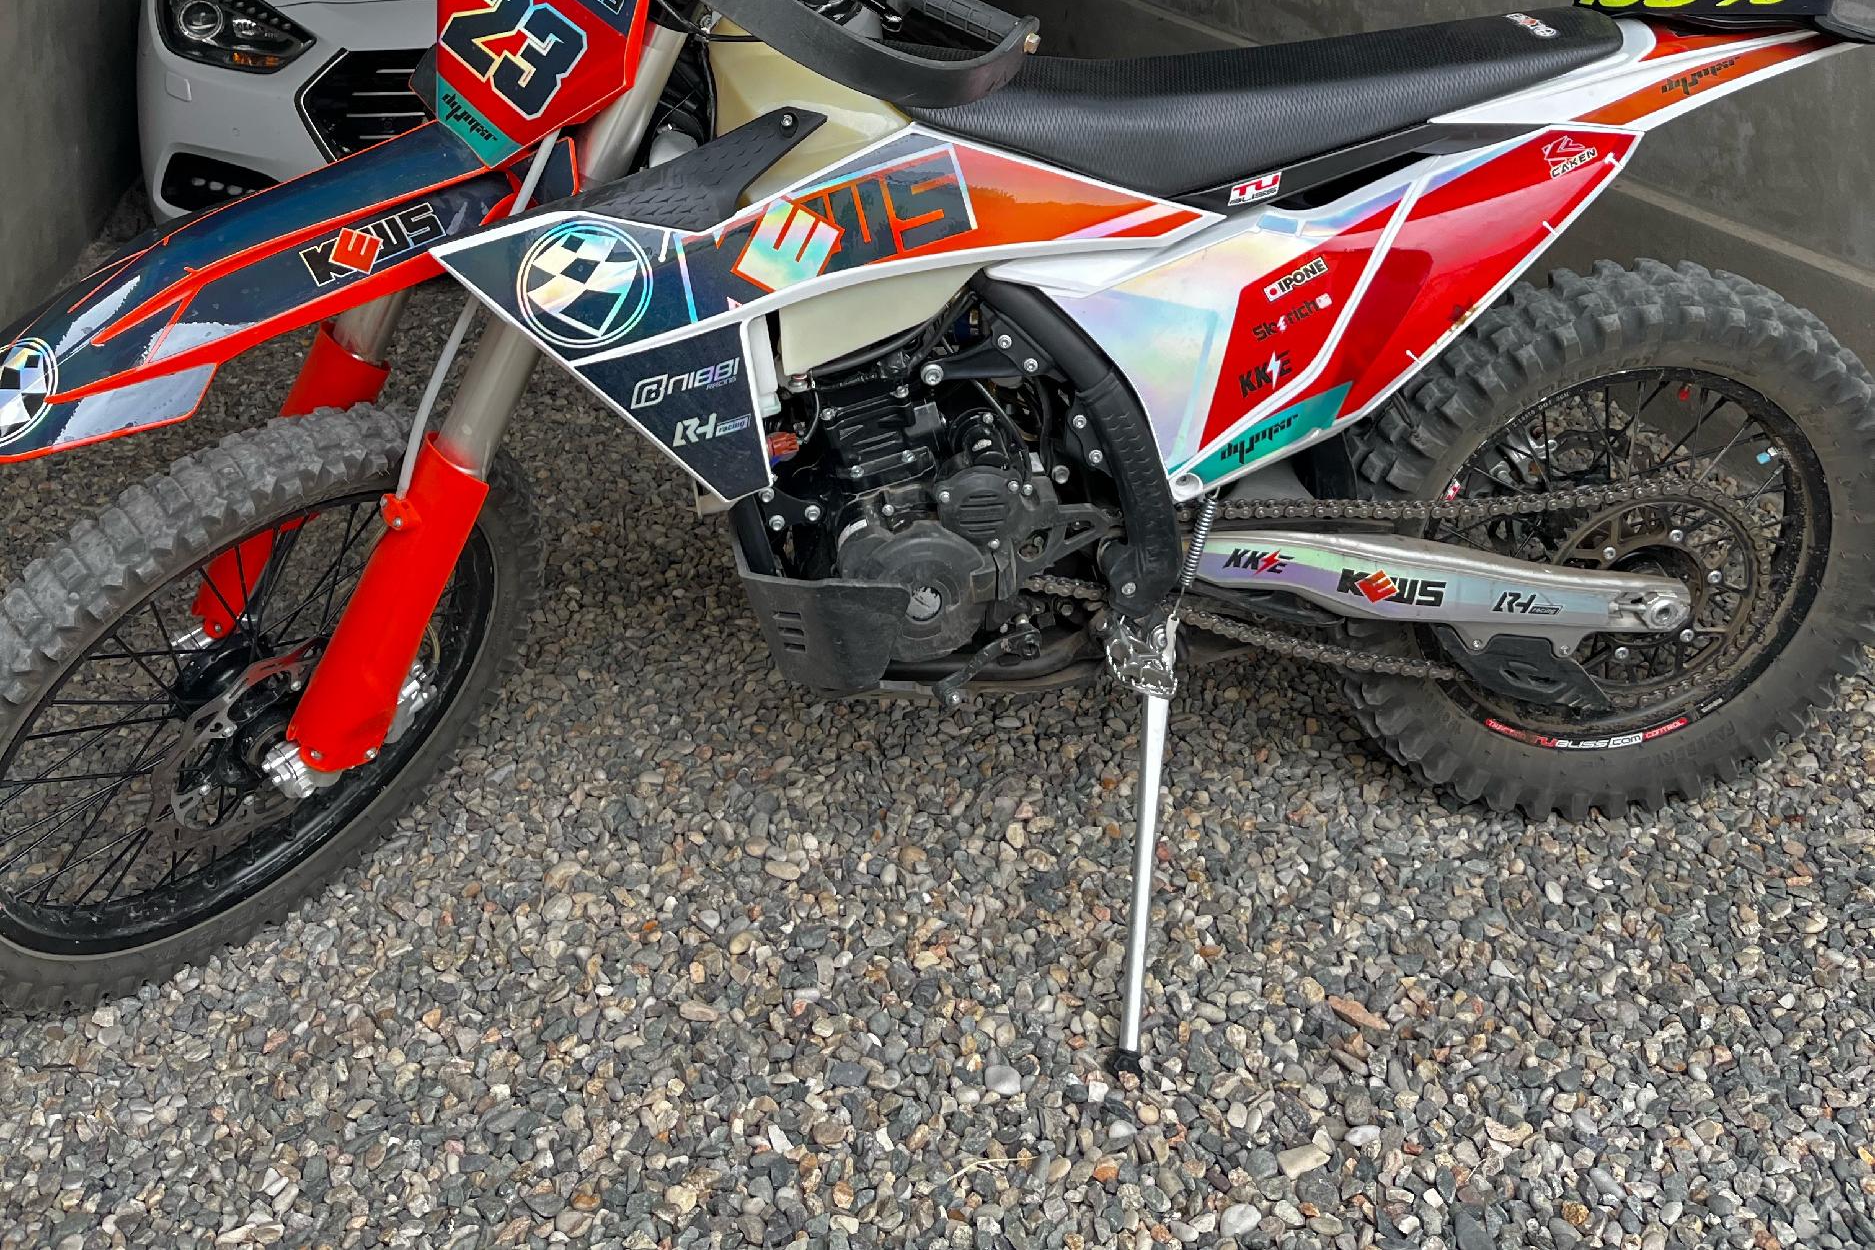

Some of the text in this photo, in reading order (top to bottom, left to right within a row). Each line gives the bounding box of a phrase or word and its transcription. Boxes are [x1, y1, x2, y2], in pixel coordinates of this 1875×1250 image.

[1551, 147, 1597, 178] CAKEN
[299, 202, 447, 287] KEWS
[1277, 259, 1326, 293] IPONE
[1336, 568, 1447, 607] KEWS
